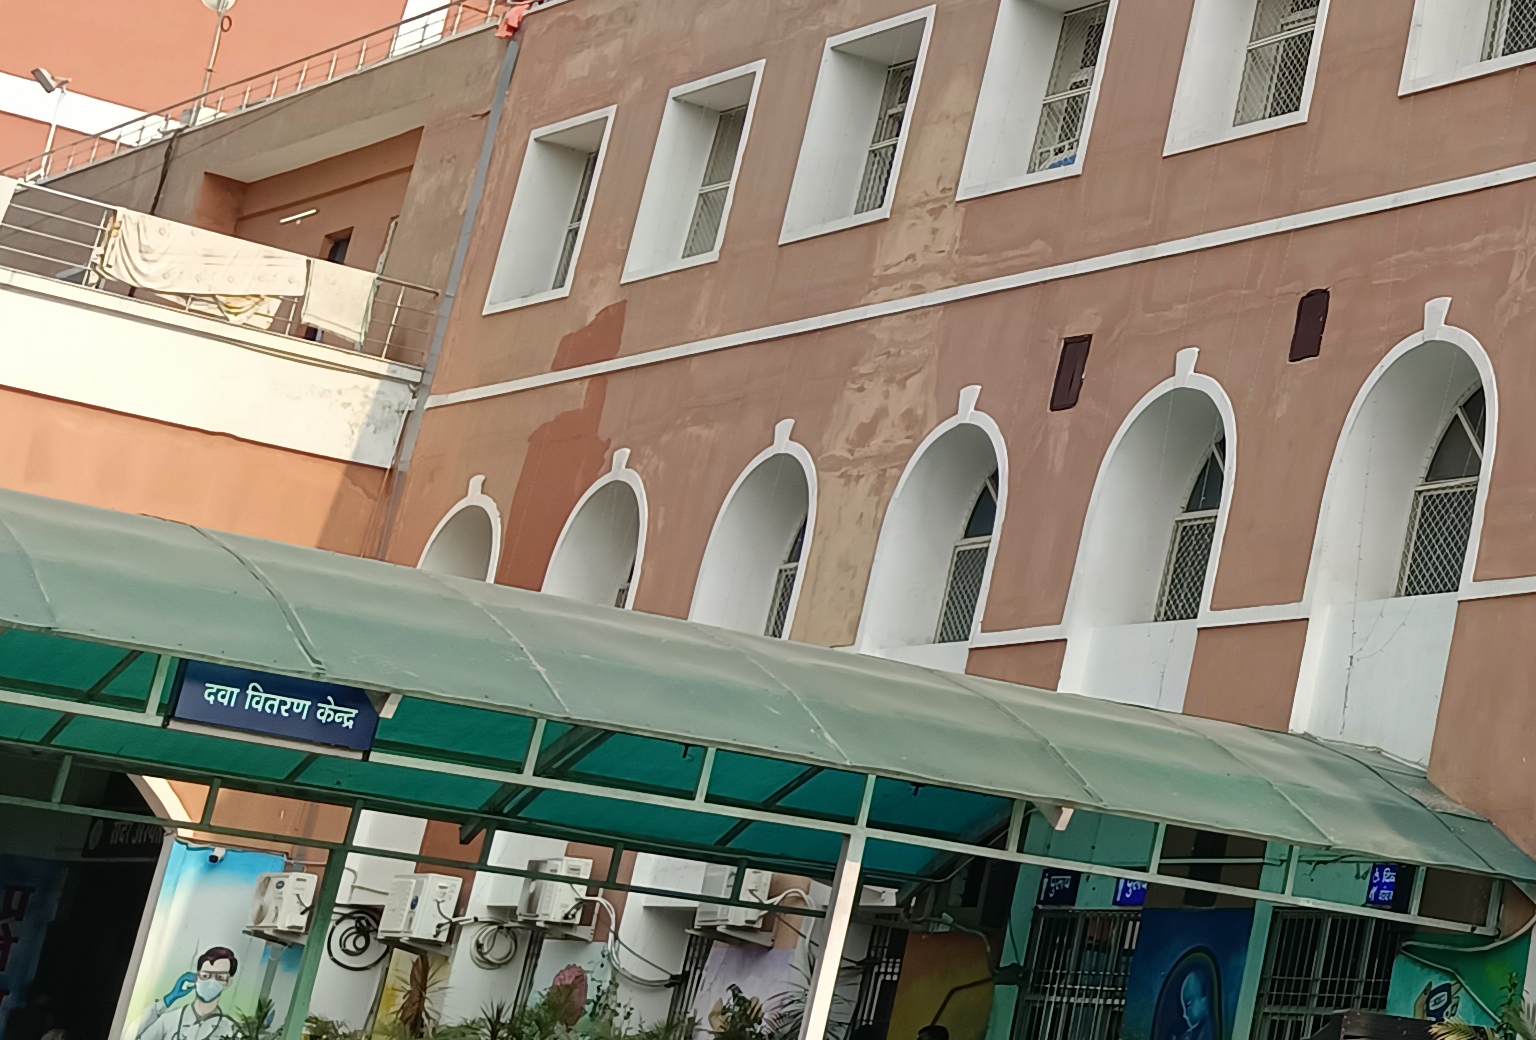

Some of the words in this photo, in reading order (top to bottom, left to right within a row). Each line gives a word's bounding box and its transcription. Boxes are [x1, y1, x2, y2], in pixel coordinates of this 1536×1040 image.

[204, 683, 240, 707] दवा
[245, 683, 311, 719] वितरण
[317, 696, 358, 728] केन्द्र
